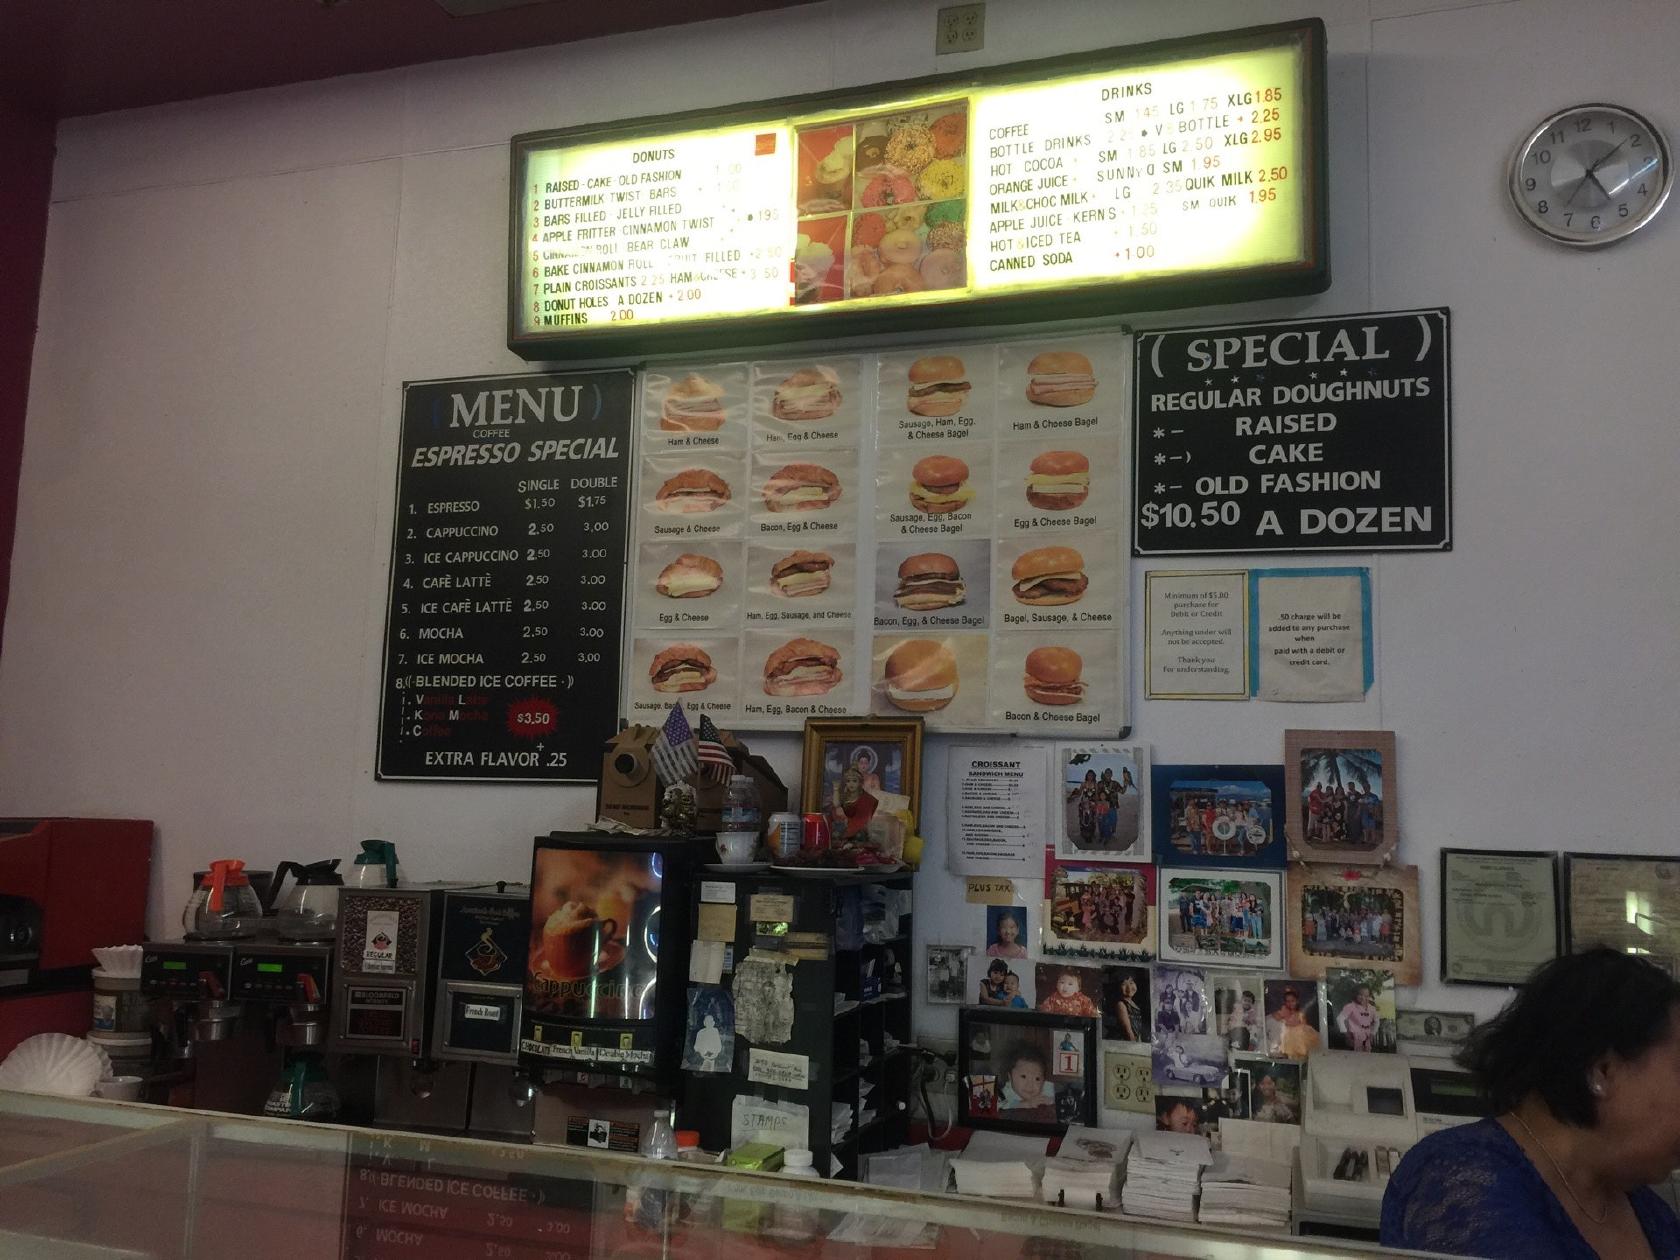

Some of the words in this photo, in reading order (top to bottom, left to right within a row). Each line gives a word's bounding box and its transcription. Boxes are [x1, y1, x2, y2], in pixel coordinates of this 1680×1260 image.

[1102, 82, 1152, 101] DRINKS
[1228, 93, 1252, 108] XLG
[1105, 110, 1125, 124] SM
[1170, 102, 1184, 115] LG
[989, 124, 1029, 140] COFFEE
[1574, 119, 1592, 132] 12
[990, 142, 1034, 158] BOTTLE
[1045, 135, 1091, 152] DRINKS
[1179, 115, 1229, 133] BOTTLE
[1550, 131, 1564, 144] 11
[1631, 134, 1642, 147] 2
[633, 149, 675, 163] DONUTS
[991, 164, 1012, 177] HOT
[1024, 157, 1063, 172] COCOA
[1099, 150, 1117, 163] SM
[1162, 142, 1176, 155] LG
[1224, 133, 1247, 148] XLG
[1251, 128, 1281, 145] 2.95
[1533, 150, 1551, 165] 10
[546, 179, 579, 193] RAISED
[588, 177, 611, 189] CAKE
[619, 173, 637, 186] OLD
[641, 170, 681, 183] FASHION
[989, 180, 1033, 195] ORANGE
[1038, 175, 1068, 189] JUICE
[1163, 160, 1182, 174] SM
[1525, 178, 1536, 191] 9
[990, 200, 1018, 214] MILK
[1026, 196, 1057, 211] CHOC
[1060, 192, 1088, 206] MILK
[1116, 187, 1130, 200] LG
[1185, 176, 1215, 191] QUIK
[1221, 171, 1252, 186] MILK
[1258, 166, 1287, 183] 2.50
[1637, 183, 1648, 196] 4
[544, 193, 604, 209] BUTTERMILK
[610, 191, 640, 202] TWIST
[649, 187, 677, 199] BARS
[544, 214, 571, 226] BARS
[575, 211, 606, 223] FILLED
[617, 207, 645, 220] JELLY
[649, 203, 682, 215] FILLED
[1538, 200, 1548, 214] 8
[1618, 203, 1628, 217] 5
[990, 219, 1024, 234] APPLE
[1030, 214, 1062, 229] JUICE
[1182, 200, 1199, 212] SM
[1210, 196, 1236, 208] QUIK
[1564, 213, 1573, 227] 7
[1591, 216, 1601, 229] 6
[543, 230, 572, 242] APPLE
[578, 226, 616, 240] FRITTER
[623, 221, 677, 235] CINNAMON
[683, 217, 715, 229] TWIST
[627, 240, 654, 252] BEAR
[660, 237, 689, 249] CLAW
[990, 239, 1012, 252] HOT
[1026, 235, 1052, 249] ICED
[1060, 231, 1081, 244] TEA
[544, 265, 570, 277] BAKE
[573, 260, 623, 275] CINNAMON
[705, 249, 740, 263] FILLED
[990, 256, 1035, 272] CANNED
[1043, 253, 1072, 266] SODA
[544, 282, 571, 295] PLAIN
[575, 277, 636, 292] CROISSANTS
[670, 272, 692, 283] HAM
[544, 298, 576, 311] DONUT
[579, 296, 608, 308] HOLES
[618, 294, 624, 304] A
[628, 291, 662, 304] DOZEN
[544, 312, 588, 325] MUFFINS
[1187, 326, 1389, 372] SPECIAL
[1151, 388, 1261, 411] REGULAR
[1273, 377, 1430, 405] DOUGHNUTS
[450, 386, 583, 428] MENU
[1235, 413, 1337, 436] RAISED
[473, 429, 510, 439] COFFEE
[411, 442, 520, 467] ESPRESSO
[528, 437, 619, 461] SPECIAL
[1249, 443, 1323, 464] CAKE
[517, 479, 560, 493] SINGLE
[570, 476, 618, 489] DOUBLE
[1195, 475, 1249, 495] OLD
[1260, 470, 1380, 493] FASHION
[428, 501, 480, 514] ESPRESSO
[524, 498, 555, 509] $1.50
[1014, 519, 1030, 528] Egg
[1040, 517, 1070, 526] Cheese
[1074, 516, 1097, 525] Bagel
[1141, 501, 1241, 529] $10.50
[1256, 511, 1283, 535] A
[1300, 506, 1432, 534] DOZEN
[426, 525, 498, 538] CAPPUCCINO
[528, 523, 554, 535] 2.50
[584, 522, 609, 532] 3.00
[787, 523, 800, 532] Egg
[803, 522, 808, 530] &
[810, 522, 838, 530] Cheese
[424, 553, 440, 564] ICE
[445, 550, 518, 563] CAPPUCCINO
[527, 549, 550, 560] 2.50
[582, 549, 607, 558] 3.00
[526, 575, 549, 585] 2.50
[580, 575, 605, 585] 3.00
[421, 603, 437, 613] ICE
[524, 600, 549, 611] 2.50
[581, 601, 606, 610] 3.00
[1081, 613, 1112, 621] Cheese
[419, 628, 463, 639] MOCHA
[523, 626, 548, 638] 2.50
[580, 627, 603, 638] 3.00
[417, 654, 434, 664] ICE
[439, 653, 484, 664] MOCHA
[521, 653, 546, 664] 2.50
[578, 653, 600, 662] 3.00
[480, 675, 500, 687] ICE
[505, 675, 556, 687] COFFEE
[517, 713, 550, 724] $3.50
[425, 752, 474, 765] EXTRA
[481, 752, 539, 766] FLAVOR
[547, 753, 567, 766] .25
[971, 760, 1021, 769] CROISSANT
[968, 884, 991, 893] PLUS
[366, 951, 393, 960] REGULAR
